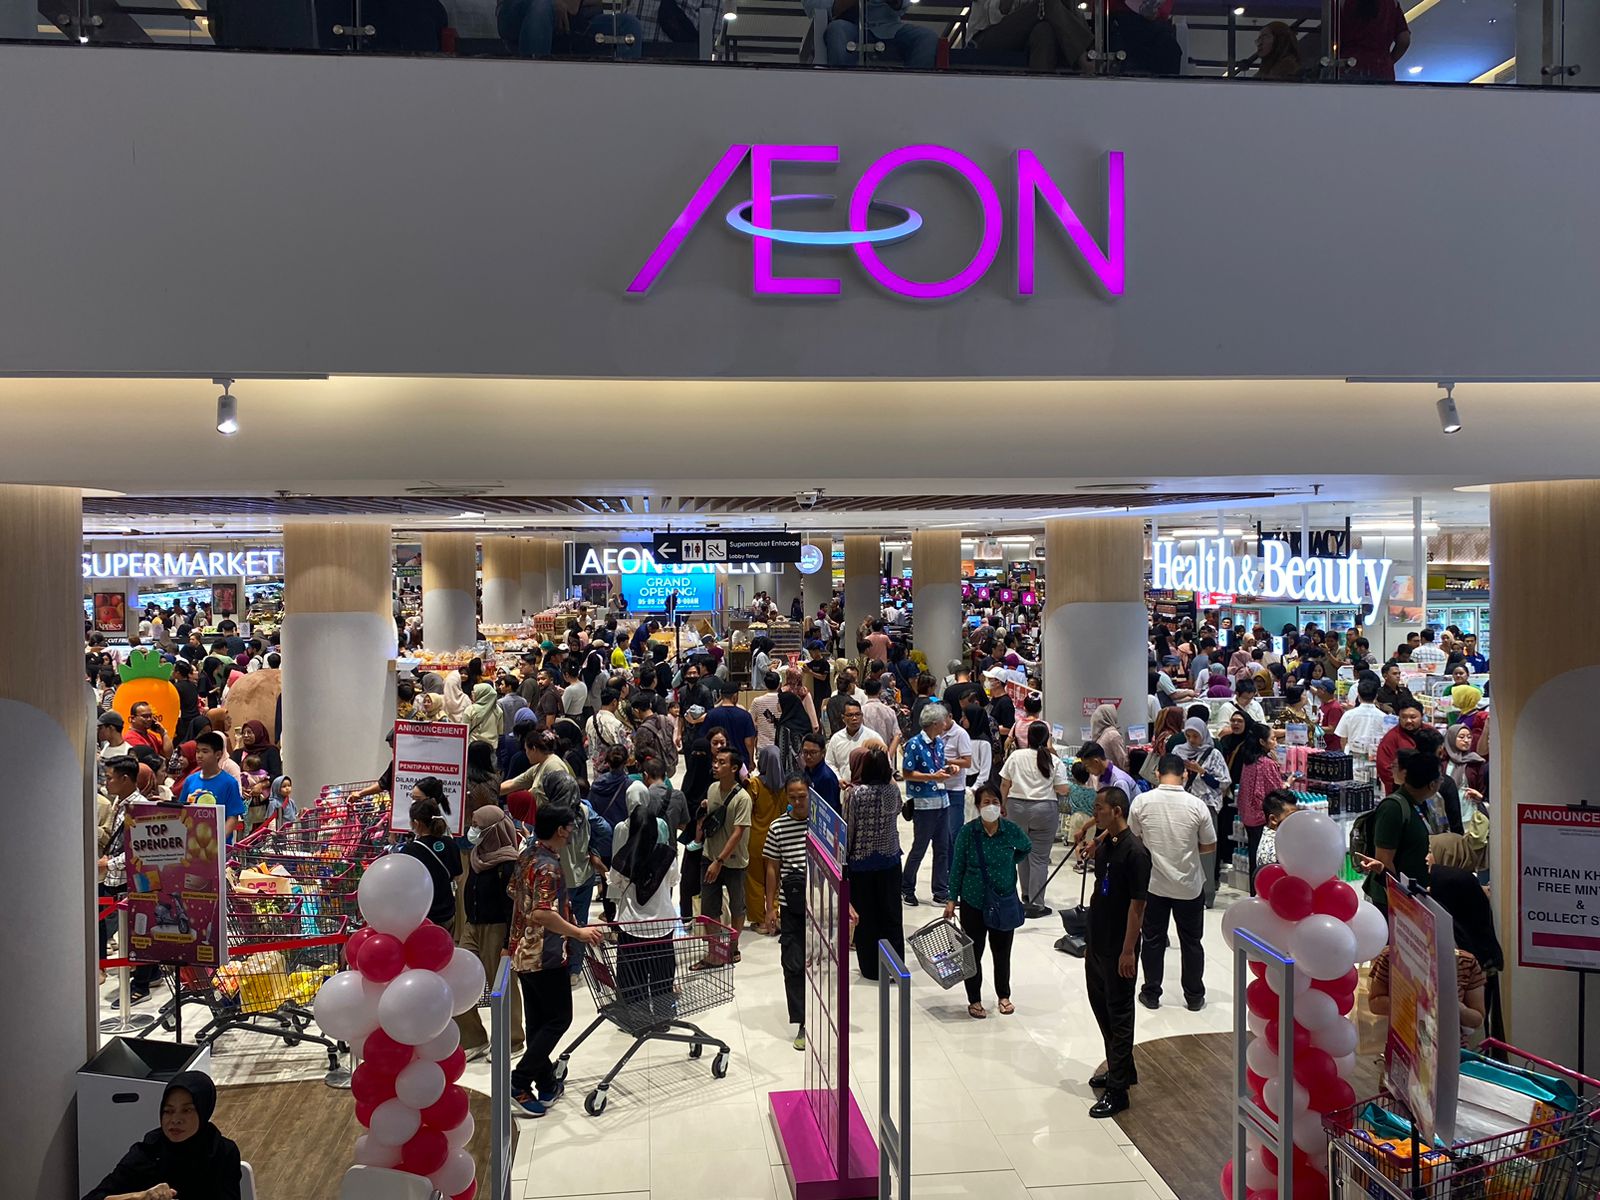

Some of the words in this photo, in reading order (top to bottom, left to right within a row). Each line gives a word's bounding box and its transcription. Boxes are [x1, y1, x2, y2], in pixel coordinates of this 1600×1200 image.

[646, 577, 691, 587] GRAND
[1152, 538, 1238, 594] Health
[1238, 555, 1258, 595] &
[1262, 540, 1392, 626] Beauty
[639, 587, 697, 597] OPENNG!
[981, 589, 987, 597] 6
[1003, 592, 1009, 600] 5
[1025, 594, 1031, 603] 4
[397, 724, 464, 735] ANNOUNCEMENT
[399, 763, 431, 771] PENITIPAN
[395, 776, 421, 784] DILARA
[145, 824, 169, 837] TOP
[132, 836, 185, 852] SPENDER
[1523, 866, 1580, 880] ANTRIAN
[1537, 881, 1571, 894] FREE
[1576, 900, 1585, 910] &
[1527, 911, 1588, 926] COLLECT
[1591, 915, 1600, 926] S
